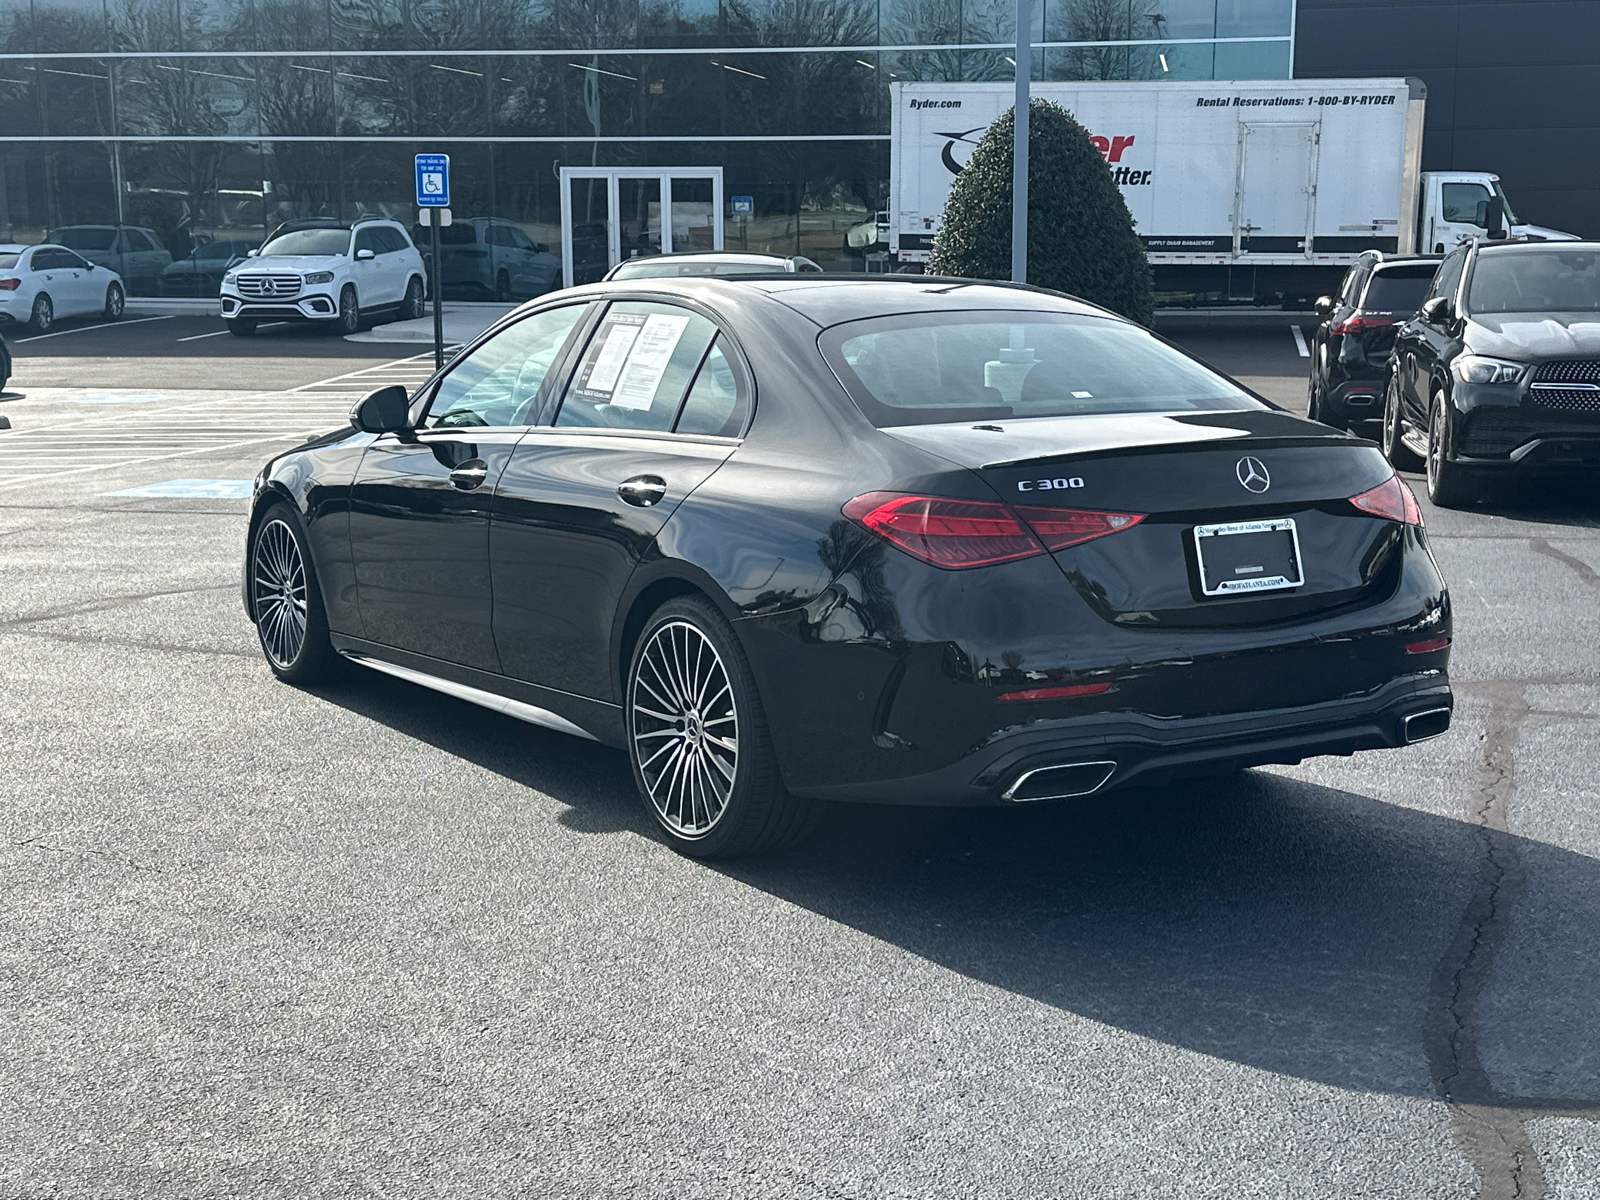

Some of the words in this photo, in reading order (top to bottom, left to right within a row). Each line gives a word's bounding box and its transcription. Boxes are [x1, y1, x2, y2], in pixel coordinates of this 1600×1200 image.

[909, 99, 962, 110] Ryder.com
[1196, 98, 1230, 107] Rental
[1232, 96, 1304, 107] Reservations:
[1308, 95, 1396, 106] 1-800-BY-RYDER
[1078, 126, 1135, 162] er
[1110, 166, 1152, 185] tter.
[1017, 480, 1033, 492] C
[1036, 477, 1085, 490] 300
